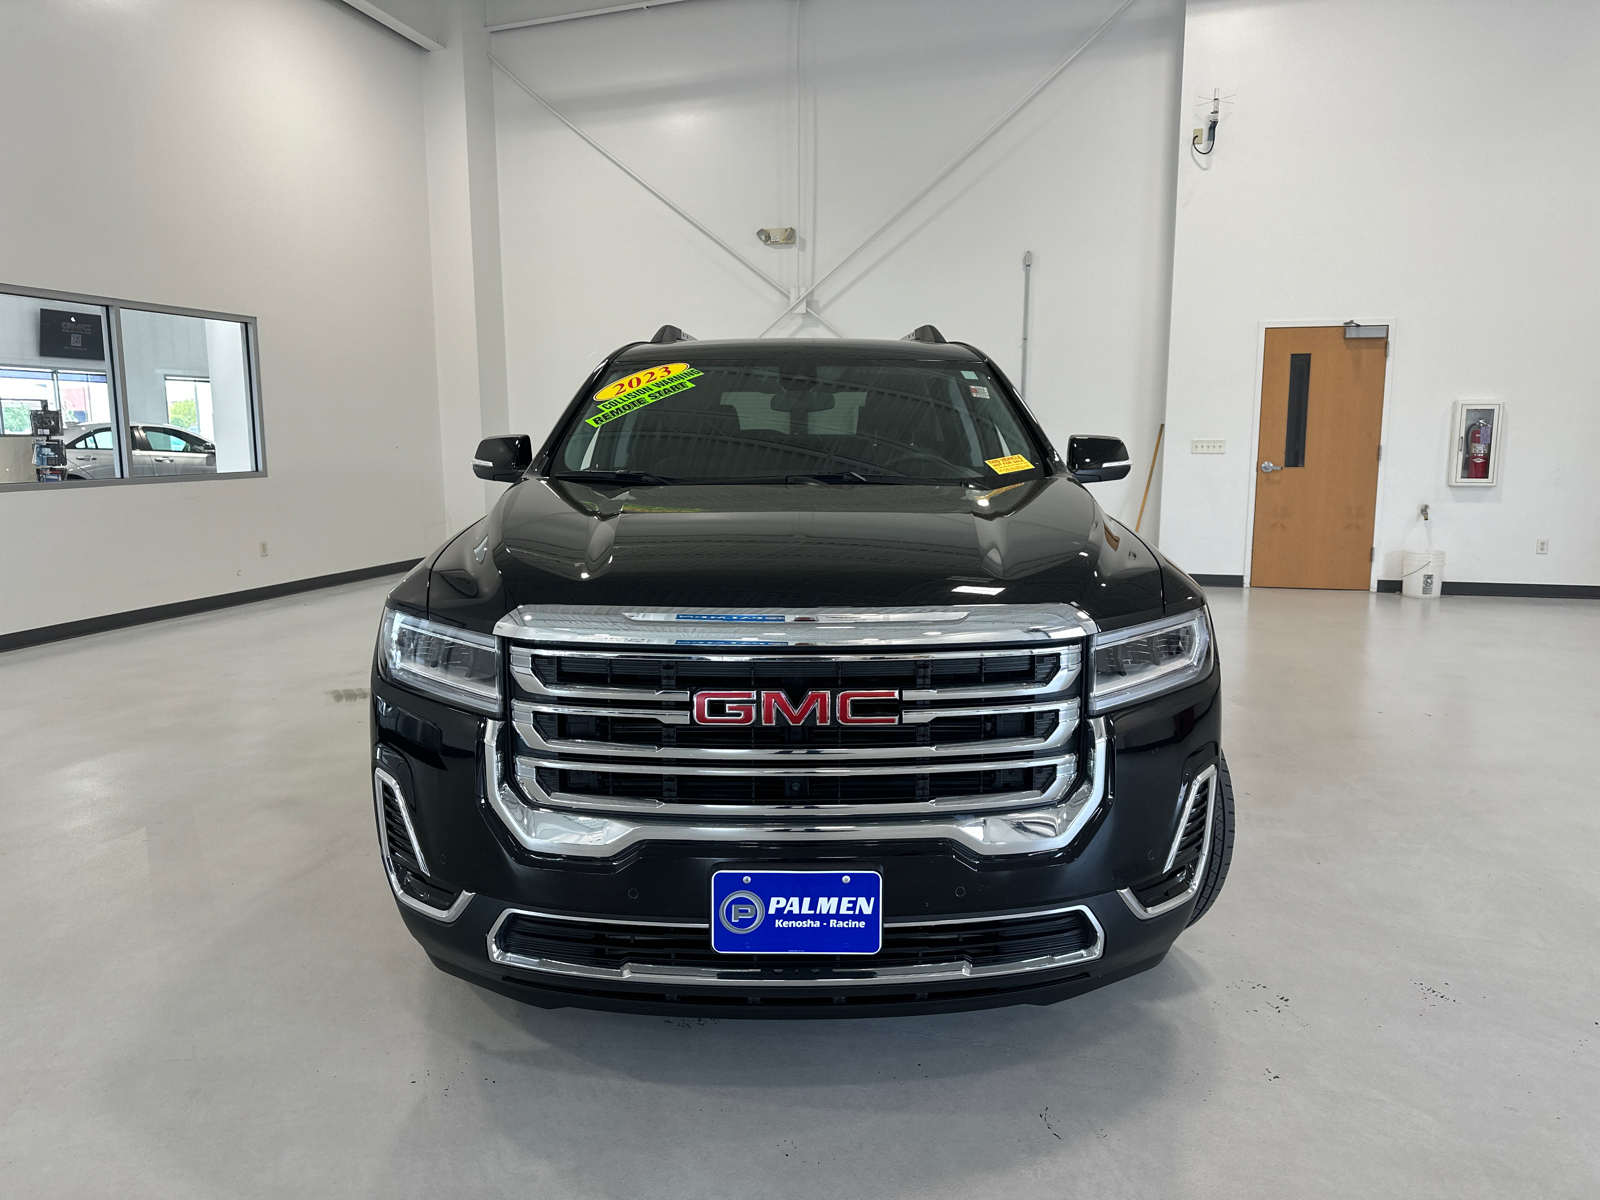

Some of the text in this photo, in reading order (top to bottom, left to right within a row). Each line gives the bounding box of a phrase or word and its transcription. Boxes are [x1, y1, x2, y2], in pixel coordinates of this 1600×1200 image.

[602, 369, 701, 410] COLLISION WARNING
[613, 366, 671, 396] 2023
[592, 381, 688, 425] REMOTE START
[693, 689, 900, 726] GMC
[768, 896, 875, 915] PALMEN
[775, 919, 820, 928] Kenosha
[829, 919, 866, 928] Racine
